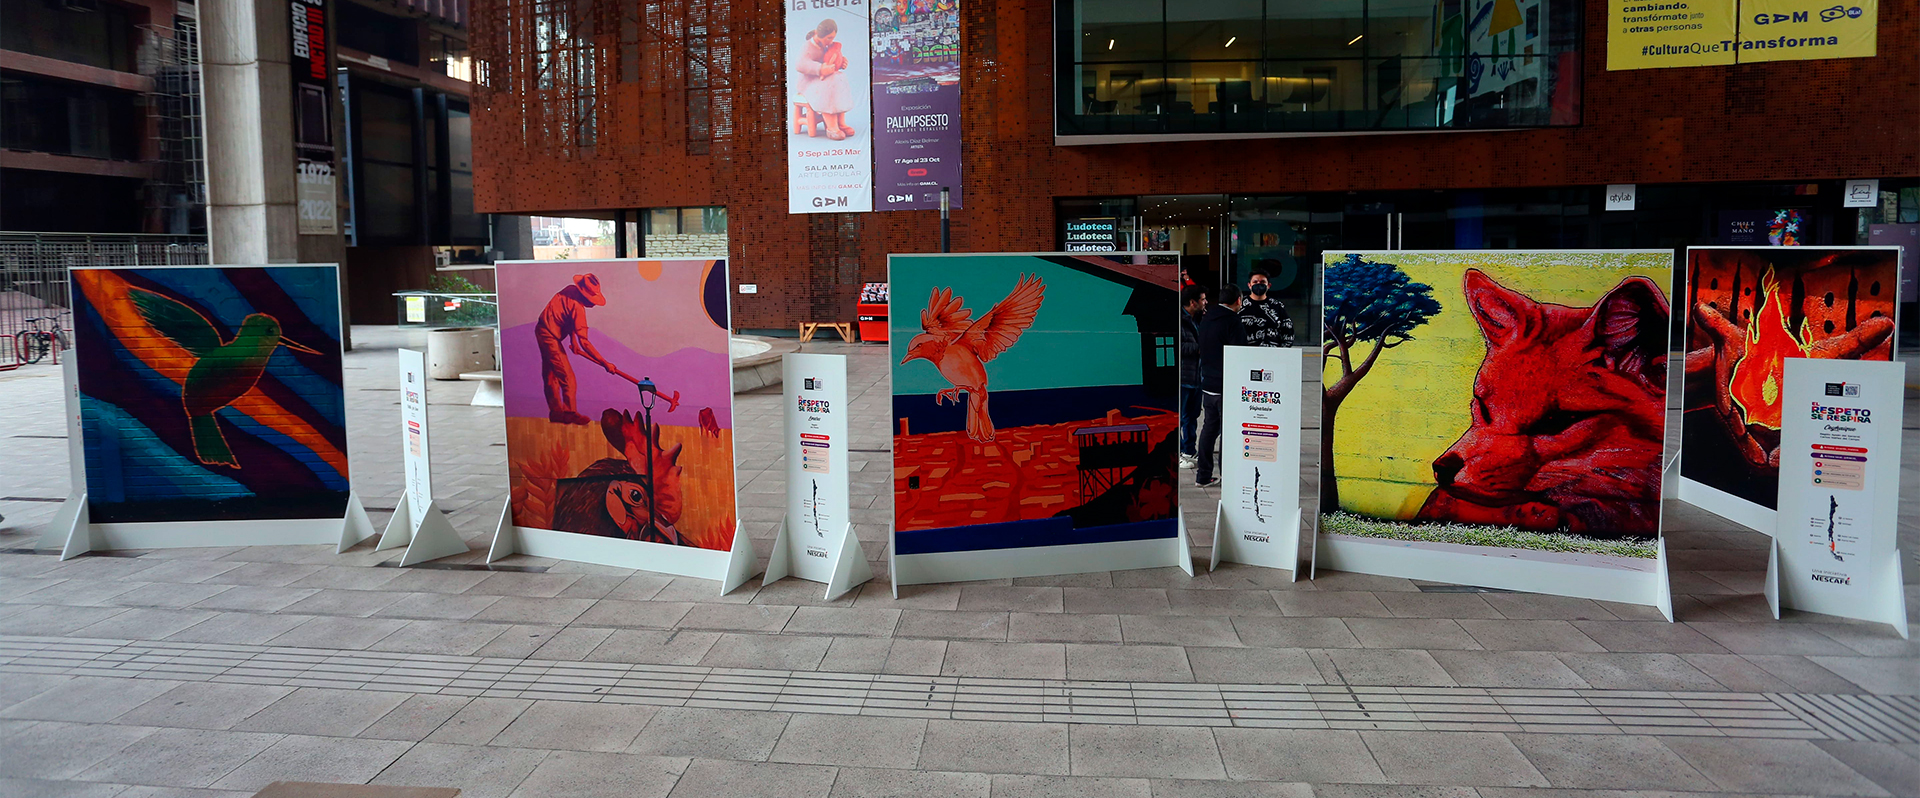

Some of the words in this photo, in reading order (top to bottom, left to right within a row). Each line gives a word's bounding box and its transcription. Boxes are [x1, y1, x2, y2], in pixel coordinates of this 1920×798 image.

[792, 0, 806, 11] la
[1623, 2, 1689, 13] cambiando,
[306, 7, 324, 24] III
[1623, 13, 1688, 23] transfórmate
[1753, 11, 1809, 25] GAM
[291, 1, 310, 59] EDIFICIO
[1629, 25, 1655, 33] otras
[1656, 22, 1703, 33] personas
[308, 24, 327, 79] UNCTAD
[886, 113, 949, 129] PALIMPSESTO
[299, 162, 331, 185] 1972
[812, 196, 848, 208] GAM
[887, 194, 914, 203] GAM
[300, 199, 332, 220] 2022
[1066, 222, 1113, 230] Ludoteca
[1066, 232, 1113, 240] Ludoteca
[1066, 244, 1113, 252] Ludoteca
[1241, 391, 1281, 399] RESPETO
[798, 400, 830, 408] RESPETO
[1811, 406, 1871, 417] RESPETO
[1826, 415, 1871, 423] RESPIRA
